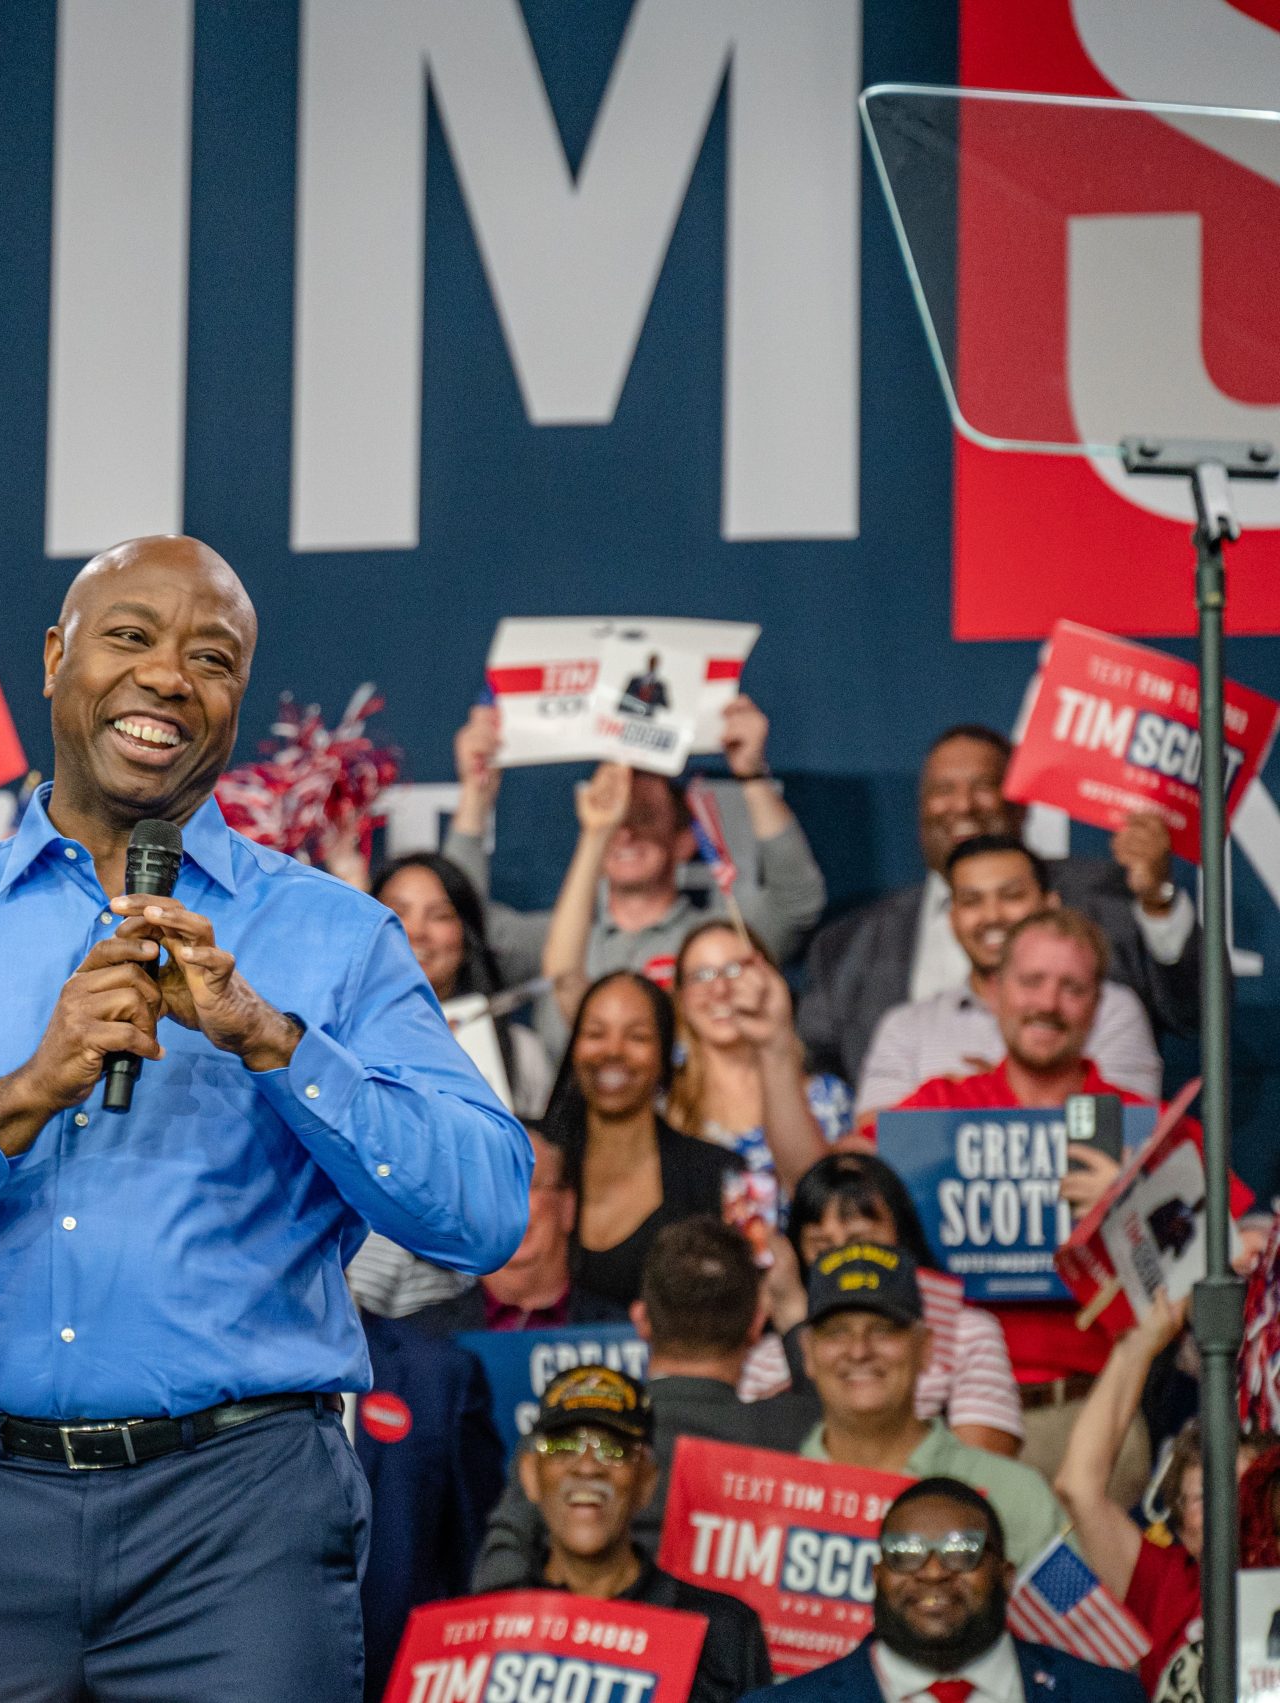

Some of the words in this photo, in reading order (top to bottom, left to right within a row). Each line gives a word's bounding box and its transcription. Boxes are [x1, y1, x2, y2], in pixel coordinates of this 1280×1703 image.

[1052, 686, 1138, 758] TIM
[1129, 712, 1245, 790] SCOT
[955, 1121, 1069, 1178] GREAT
[722, 1472, 776, 1502] TEXT
[782, 1481, 826, 1513] TIM
[831, 1491, 860, 1519] TO
[689, 1511, 784, 1588] TIM
[783, 1530, 881, 1600] SCO
[492, 1614, 534, 1639] TIM
[539, 1615, 569, 1641] TO
